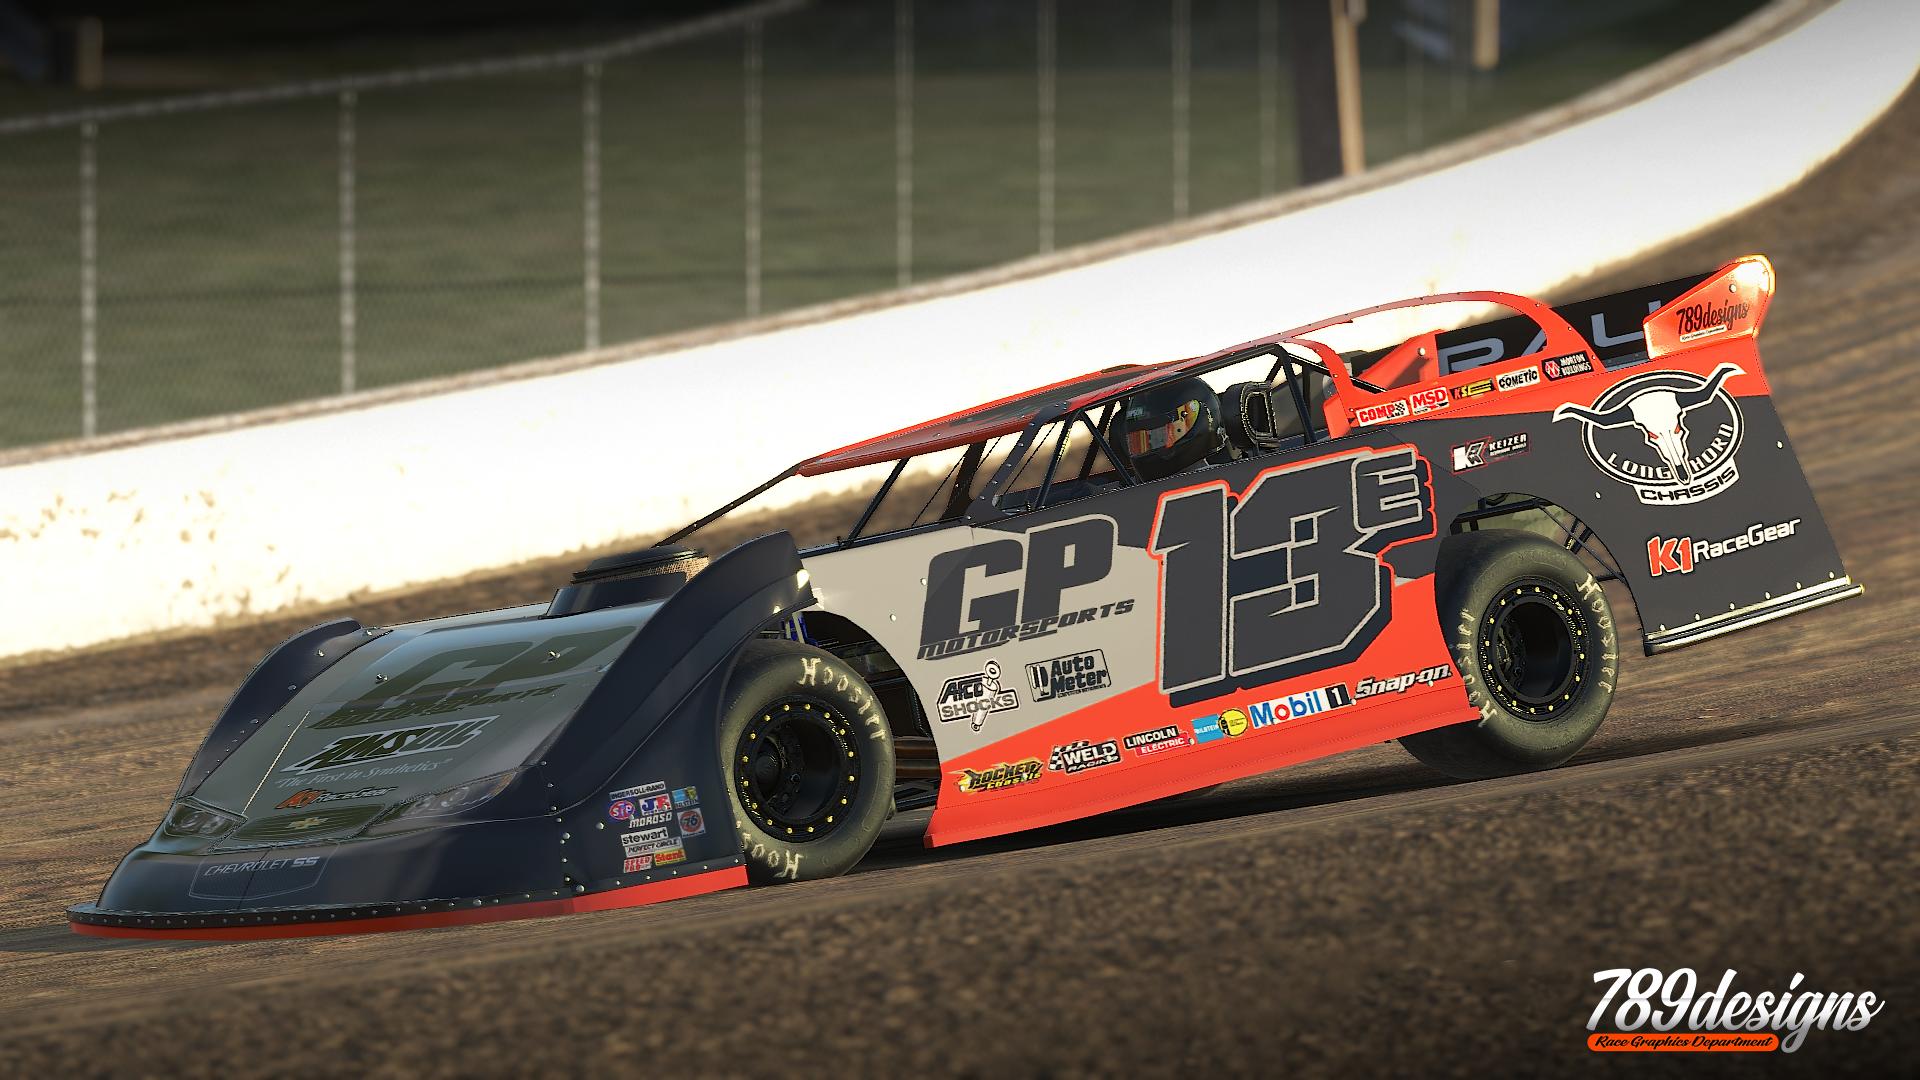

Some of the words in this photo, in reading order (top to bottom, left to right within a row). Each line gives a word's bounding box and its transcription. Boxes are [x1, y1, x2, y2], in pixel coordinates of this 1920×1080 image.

[1676, 300, 1750, 335] 789designs
[1412, 389, 1447, 409] MSD
[1359, 404, 1396, 423] COMP
[1489, 433, 1527, 451] KEIZER
[1640, 466, 1736, 501] CHASSIS
[920, 519, 1114, 647] GP
[917, 598, 1135, 660] MOTORSPORTS
[1051, 655, 1095, 677] Auto
[1050, 669, 1108, 699] Meter
[1354, 664, 1450, 699] Snap-on
[942, 694, 1015, 718] SHOCKS
[1250, 690, 1323, 728] Mobil
[1331, 687, 1344, 706] 1
[282, 716, 498, 774] AMSOIL
[1126, 728, 1177, 747] LINCOLN
[1141, 737, 1185, 753] ELECTRIC
[1063, 742, 1117, 766] WELD
[612, 803, 632, 817] STP
[629, 812, 673, 828] MOROSO
[623, 828, 668, 845] stewart
[627, 842, 655, 853] PERFECT
[655, 839, 679, 848] CIRCLE
[203, 858, 291, 876] CHEVROLET
[291, 856, 320, 868] SS
[625, 856, 651, 866] SPEED
